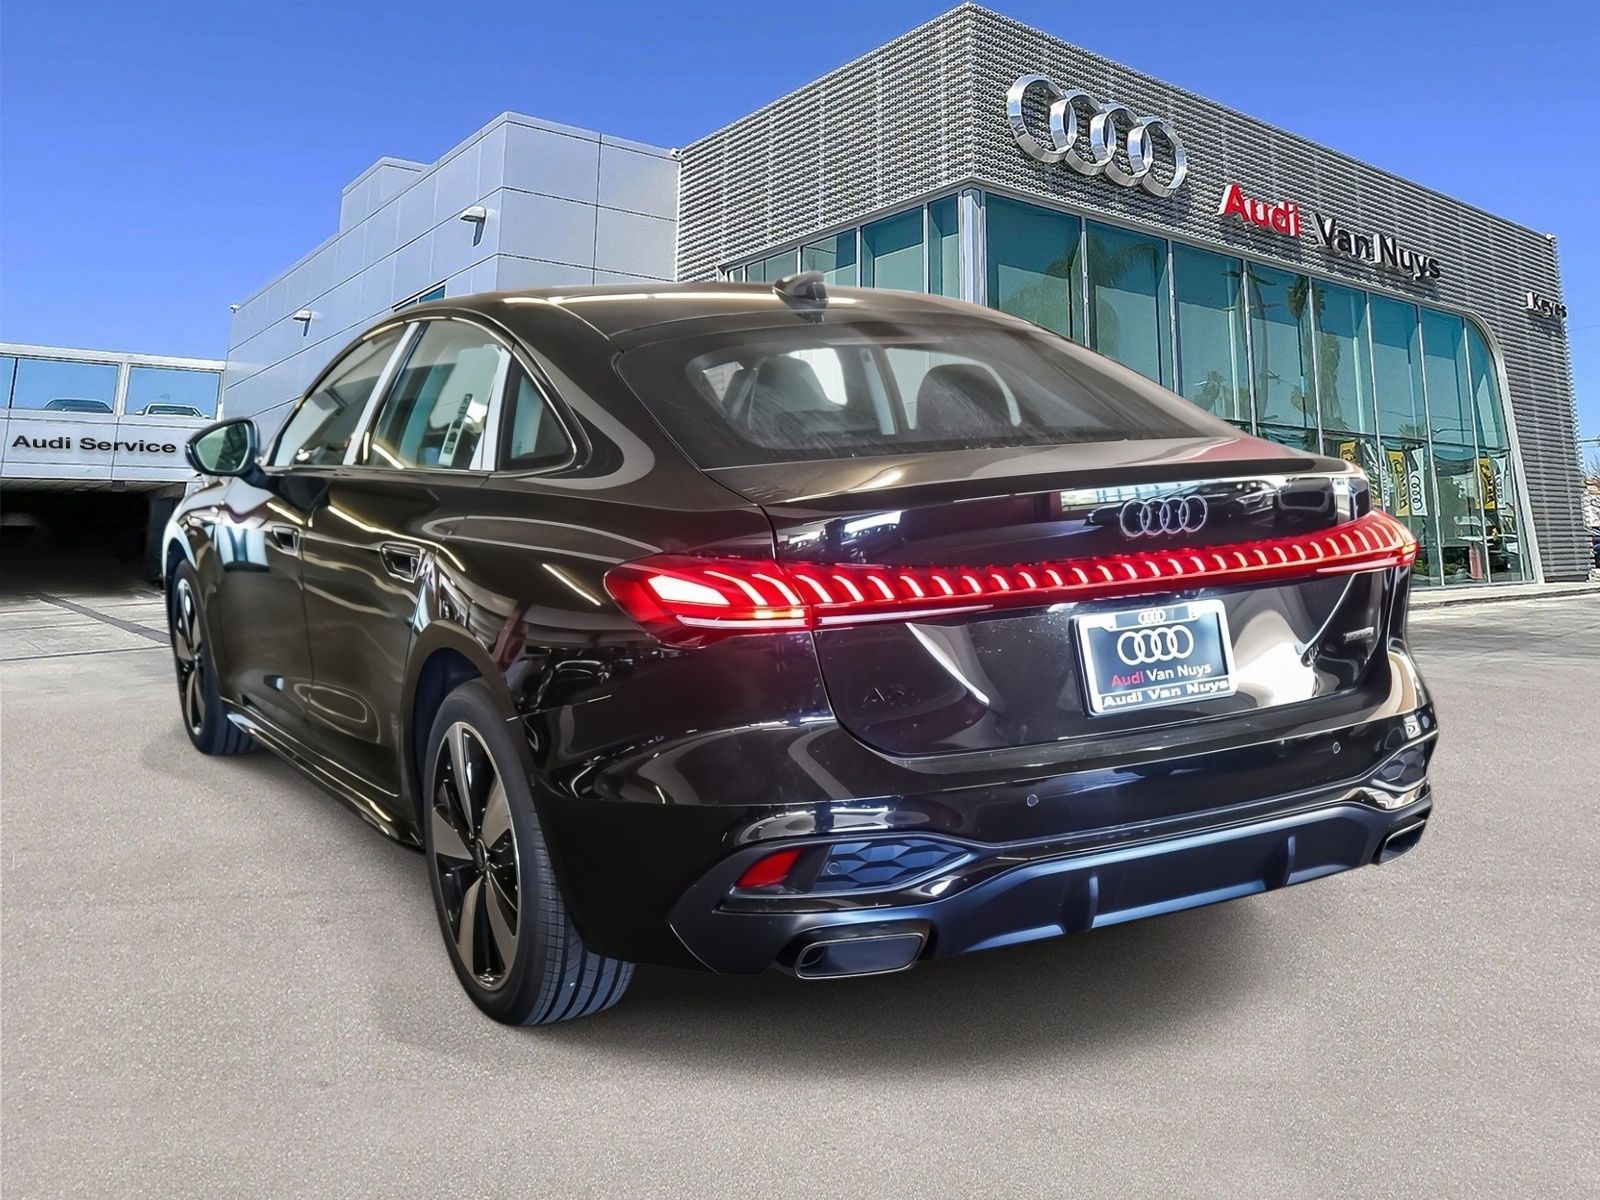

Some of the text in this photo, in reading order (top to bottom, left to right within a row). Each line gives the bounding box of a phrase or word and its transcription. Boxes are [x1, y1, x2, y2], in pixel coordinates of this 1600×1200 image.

[1217, 182, 1442, 281] Audi Van Nuys
[1526, 291, 1568, 319] Keyes
[12, 435, 177, 453] Audi Service
[1111, 663, 1212, 688] Audi Van Nuys
[1102, 679, 1230, 708] Audi Van Nuys
